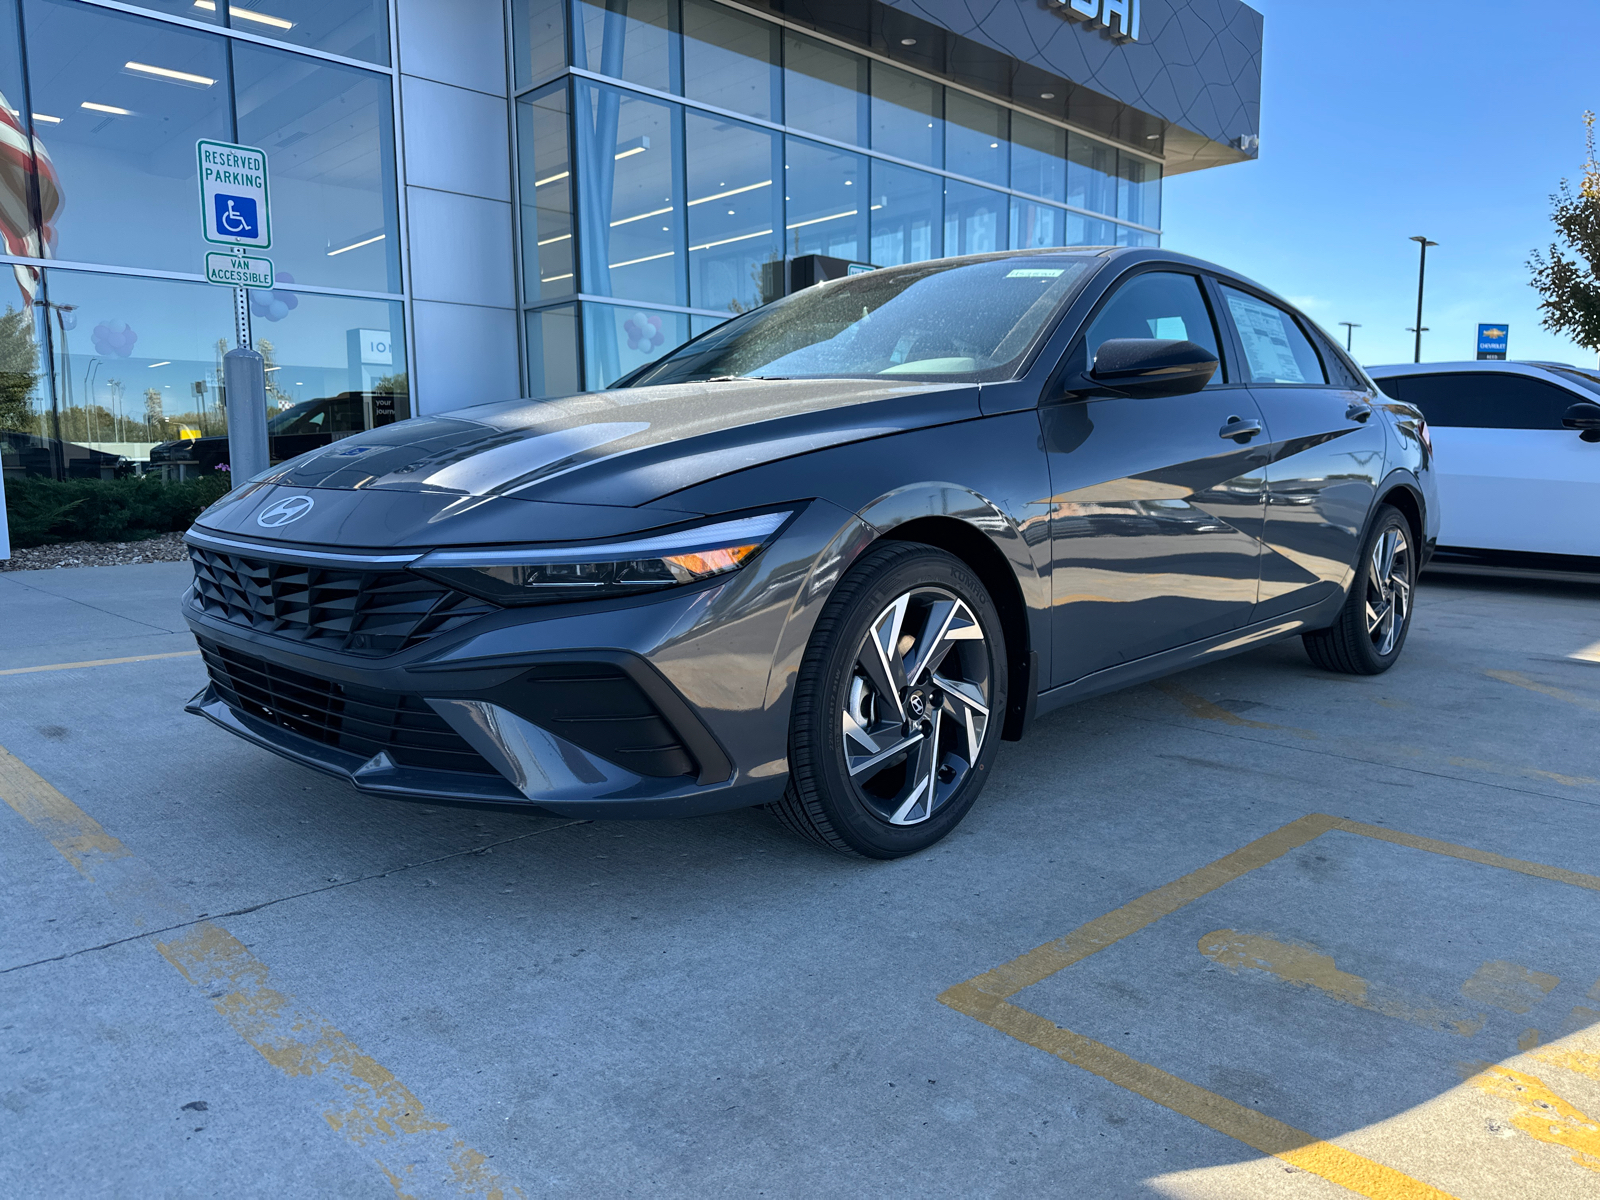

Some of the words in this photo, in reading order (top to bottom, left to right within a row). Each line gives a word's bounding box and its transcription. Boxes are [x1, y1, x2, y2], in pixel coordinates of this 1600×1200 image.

[204, 150, 260, 171] RESERVED
[205, 167, 262, 189] PARKING
[231, 259, 250, 270] VAN
[211, 268, 270, 284] ACCESSIBLE
[950, 567, 986, 605] KUMHO
